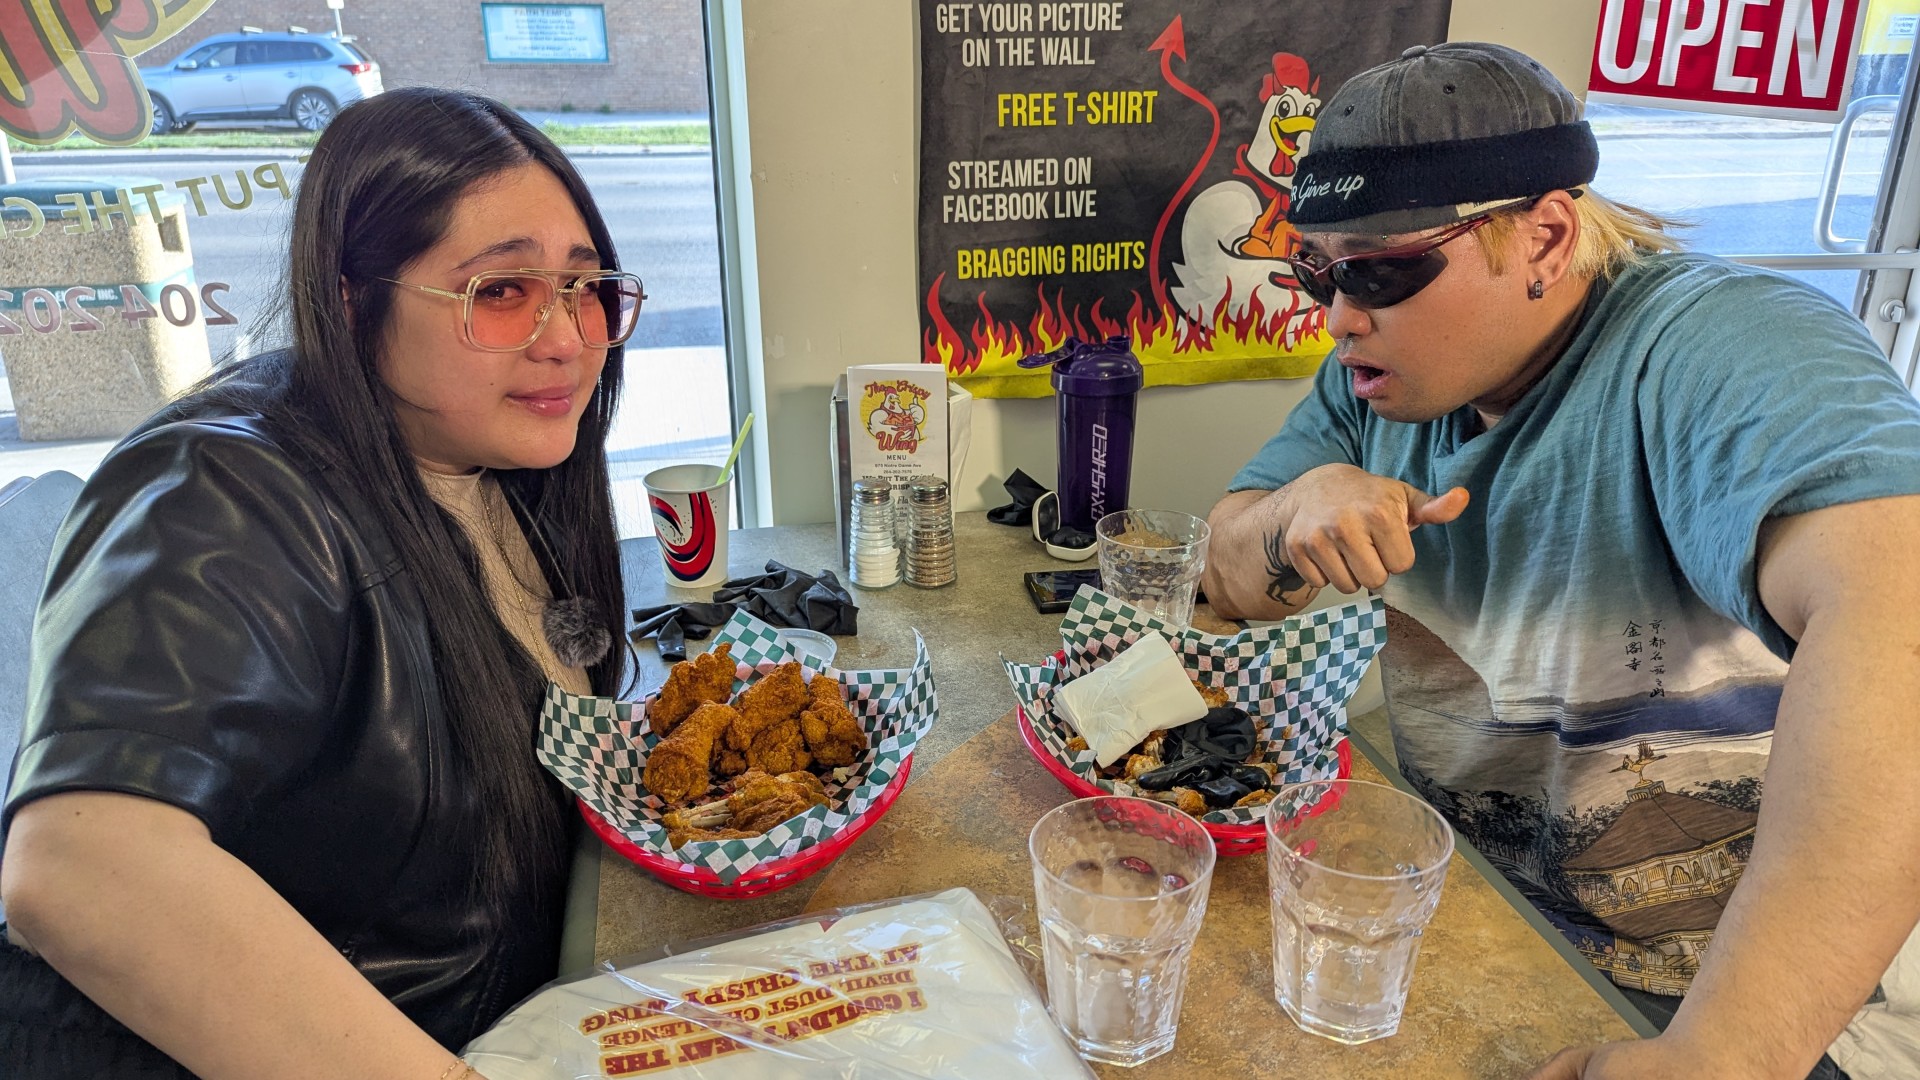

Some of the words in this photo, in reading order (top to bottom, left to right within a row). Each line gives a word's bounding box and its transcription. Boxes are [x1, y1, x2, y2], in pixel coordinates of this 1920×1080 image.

[936, 4, 973, 33] GET
[978, 3, 1033, 33] YOUR
[1038, 2, 1124, 32] PICTURE
[962, 38, 991, 67] ON
[995, 37, 1035, 67] THE
[1040, 37, 1096, 66] WALL
[1598, 0, 1843, 99] OPEN
[998, 92, 1057, 127] FREE
[1063, 91, 1158, 126] T-SHIRT
[947, 158, 1059, 190] STREAMED
[1064, 156, 1092, 186] ON
[943, 192, 1049, 223] FACEBOOK
[1054, 189, 1097, 218] LIVE
[1296, 173, 1330, 213] Give
[1334, 174, 1365, 200] up
[957, 245, 1066, 280] BRAGGING
[1071, 241, 1145, 273] RIGHTS
[864, 381, 887, 398] The
[896, 379, 932, 400] Crispy
[875, 430, 918, 454] Wing
[1091, 423, 1108, 522] OXYSHRED
[808, 954, 876, 979] THE
[884, 944, 920, 966] AT
[685, 968, 801, 1006] CRISPY
[840, 969, 914, 993] DEVIL
[768, 985, 835, 1015] DUST
[907, 990, 922, 1008] I
[583, 999, 670, 1033] WING
[605, 1049, 672, 1075] THE
